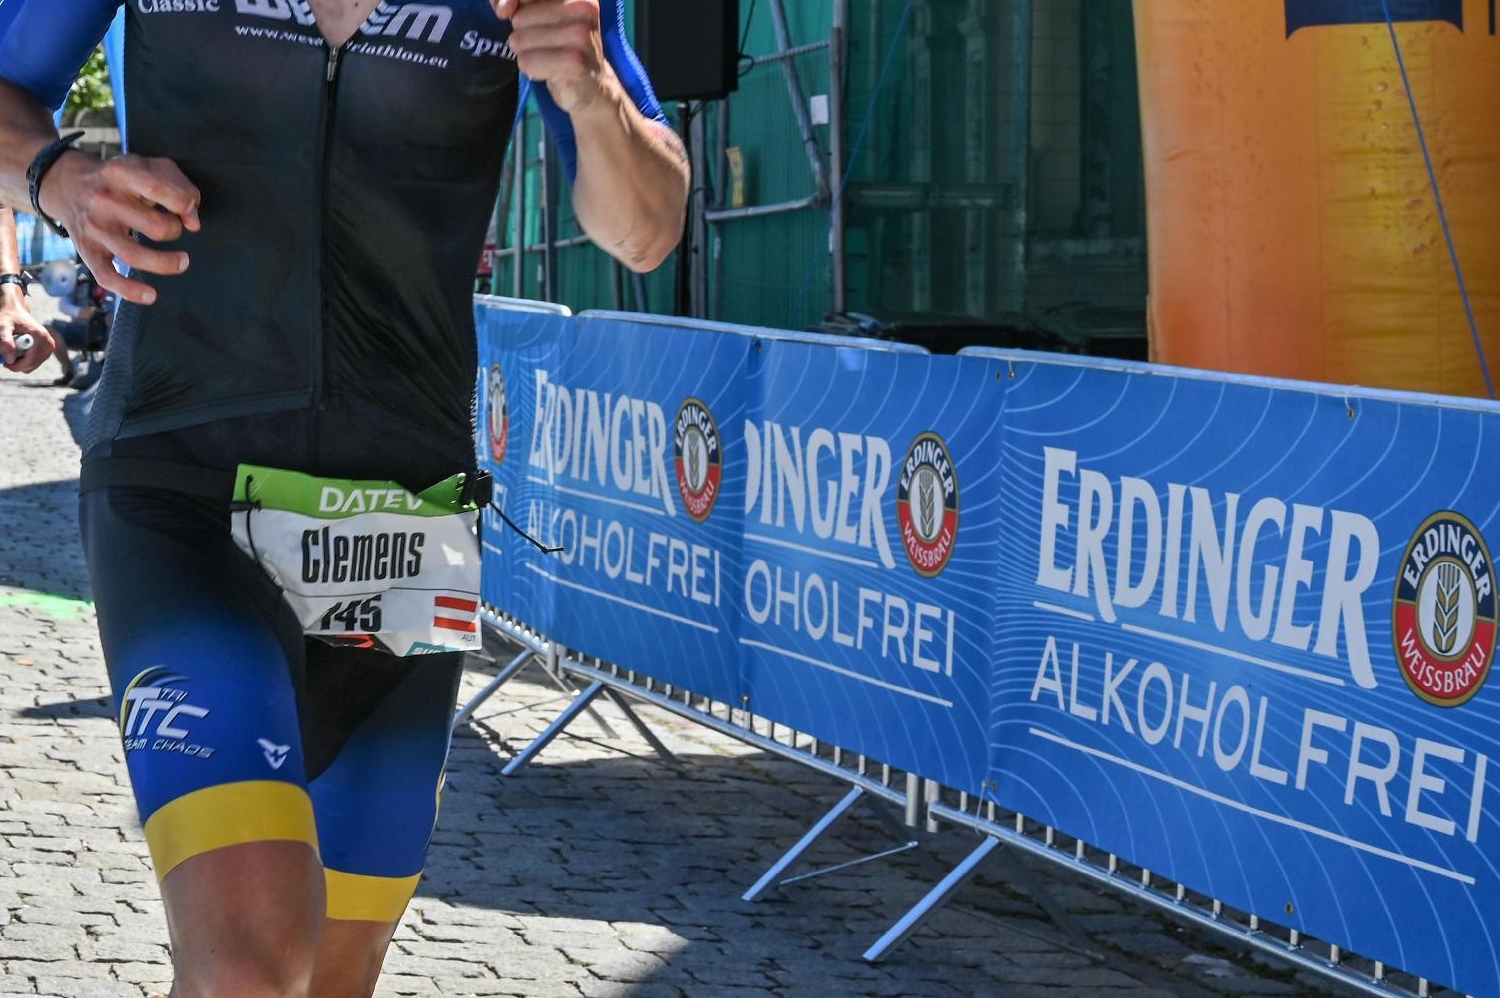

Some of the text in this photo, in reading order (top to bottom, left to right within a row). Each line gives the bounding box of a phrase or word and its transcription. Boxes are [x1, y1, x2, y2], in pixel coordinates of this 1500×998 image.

[528, 369, 677, 517] ERDINGER
[676, 404, 717, 454] ERDINGER
[319, 486, 424, 513] DATEV
[901, 441, 954, 499] ERDINGER
[301, 526, 425, 584] Clemens
[527, 499, 721, 608] ALKOHOLFREI
[1035, 446, 1380, 690] ERDINGER
[1403, 524, 1491, 603] ERDINGER
[745, 559, 955, 677] OHOLFREI
[1401, 628, 1485, 693] WEISSBRÄU
[1029, 635, 1488, 844] ALKOHOLFREI
